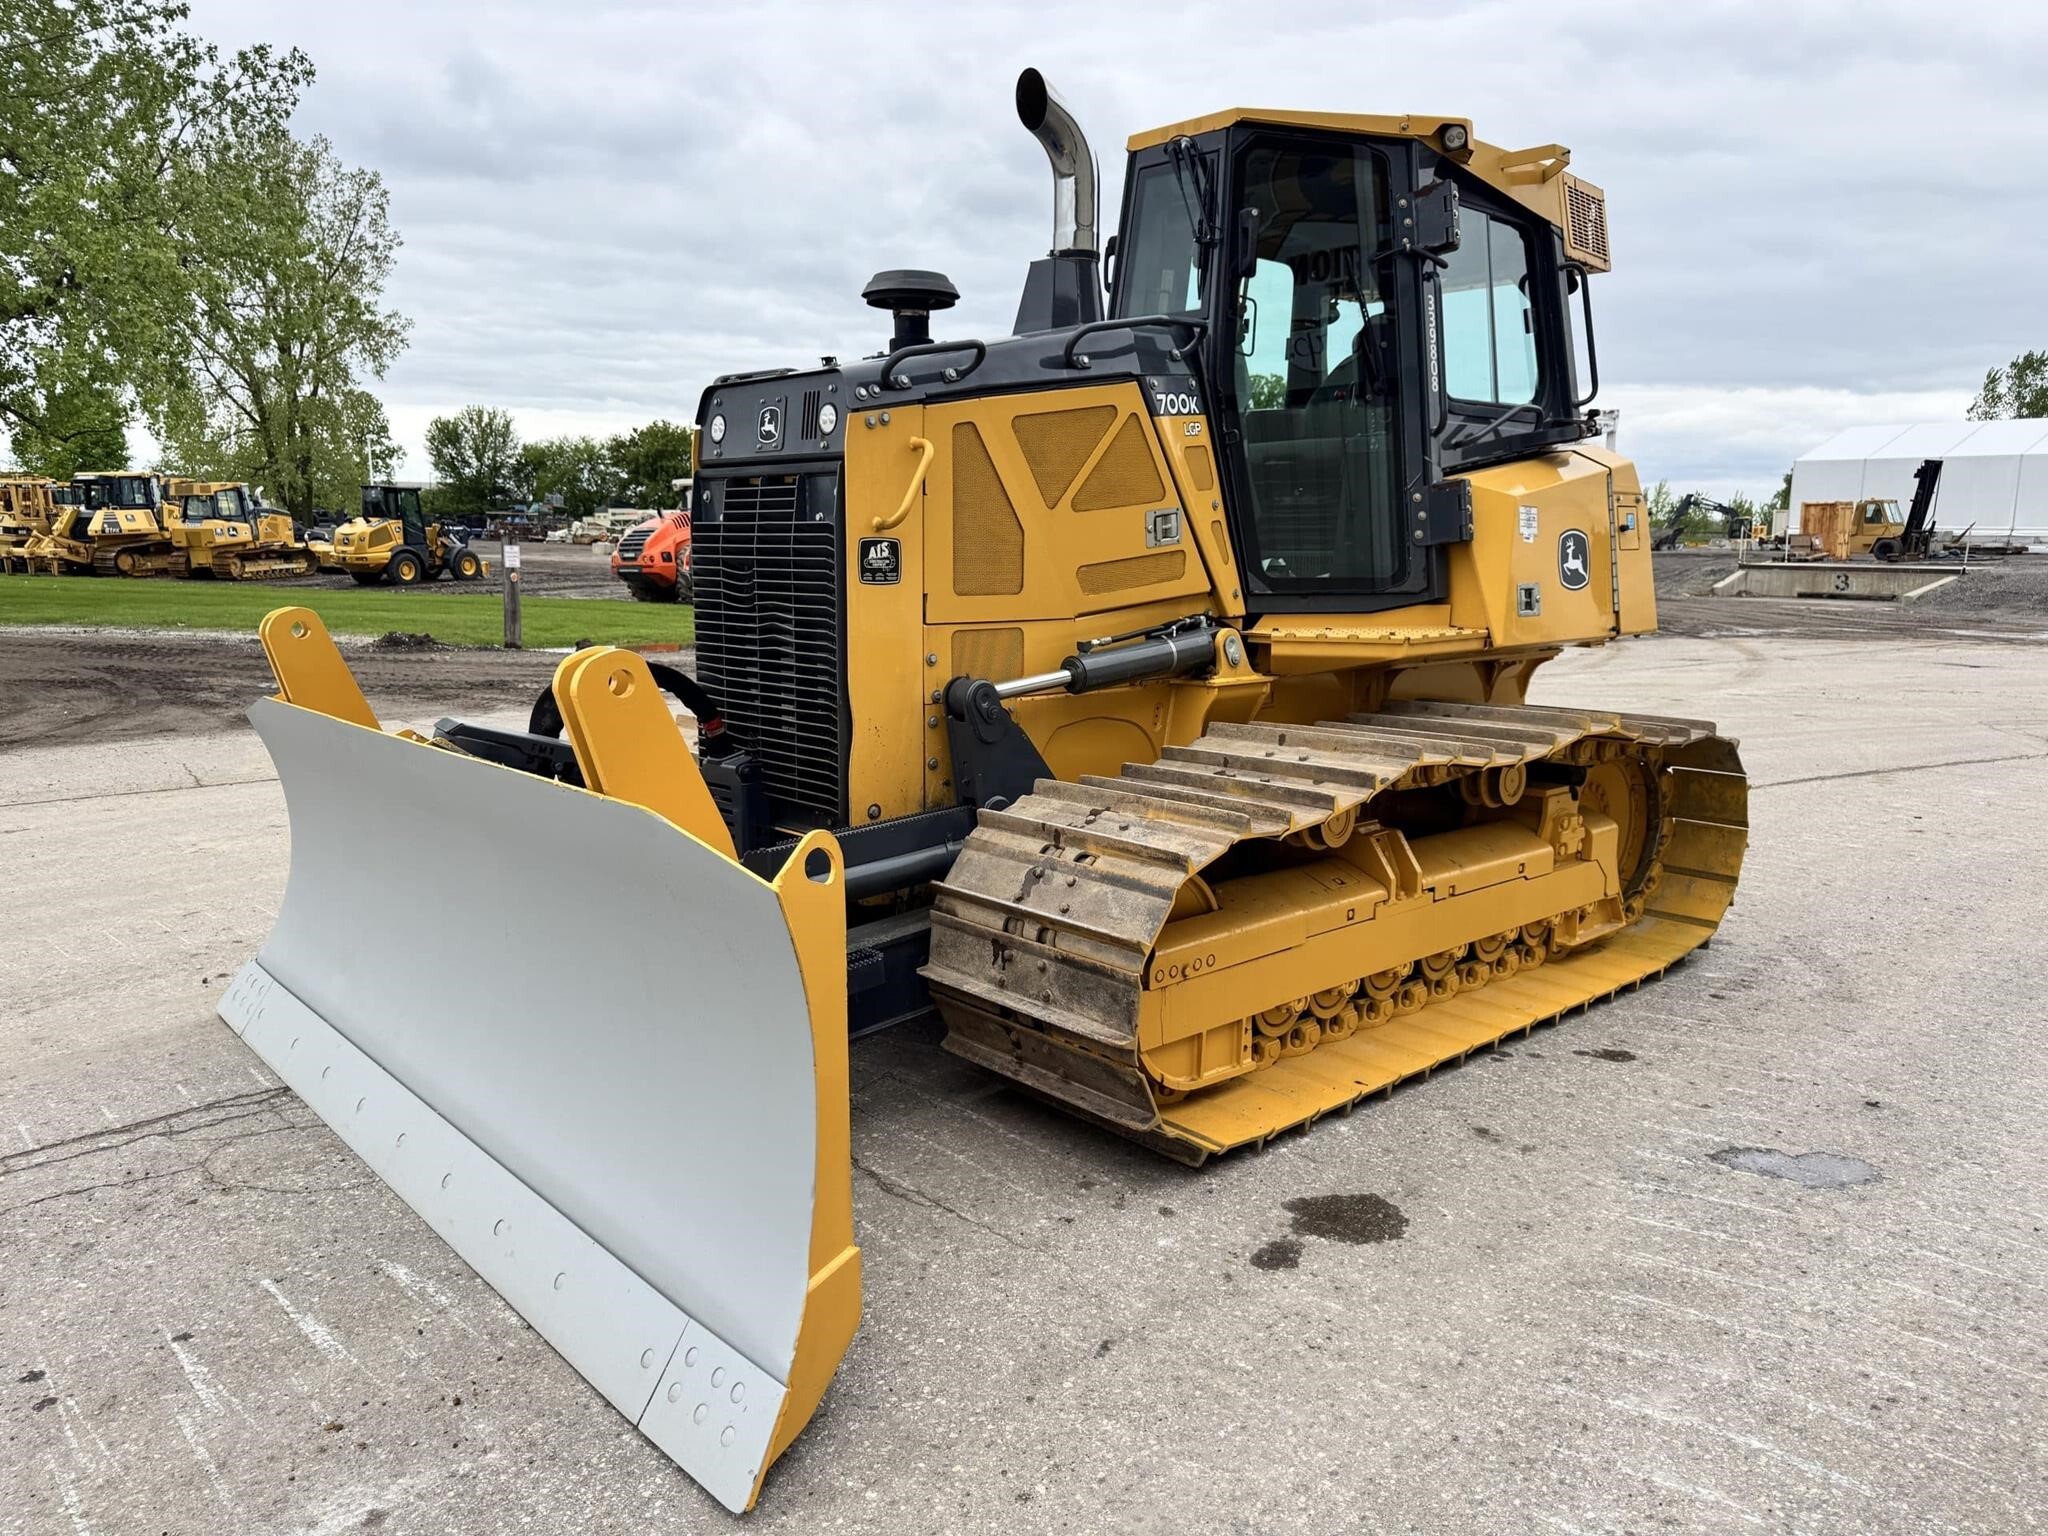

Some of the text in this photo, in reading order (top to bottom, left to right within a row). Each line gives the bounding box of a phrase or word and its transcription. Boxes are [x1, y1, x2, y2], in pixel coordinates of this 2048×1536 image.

[1428, 294, 1439, 392] 339808
[1156, 393, 1200, 415] 700K
[1183, 422, 1201, 436] LGP
[868, 541, 890, 559] AIS
[1835, 574, 1849, 591] 3
